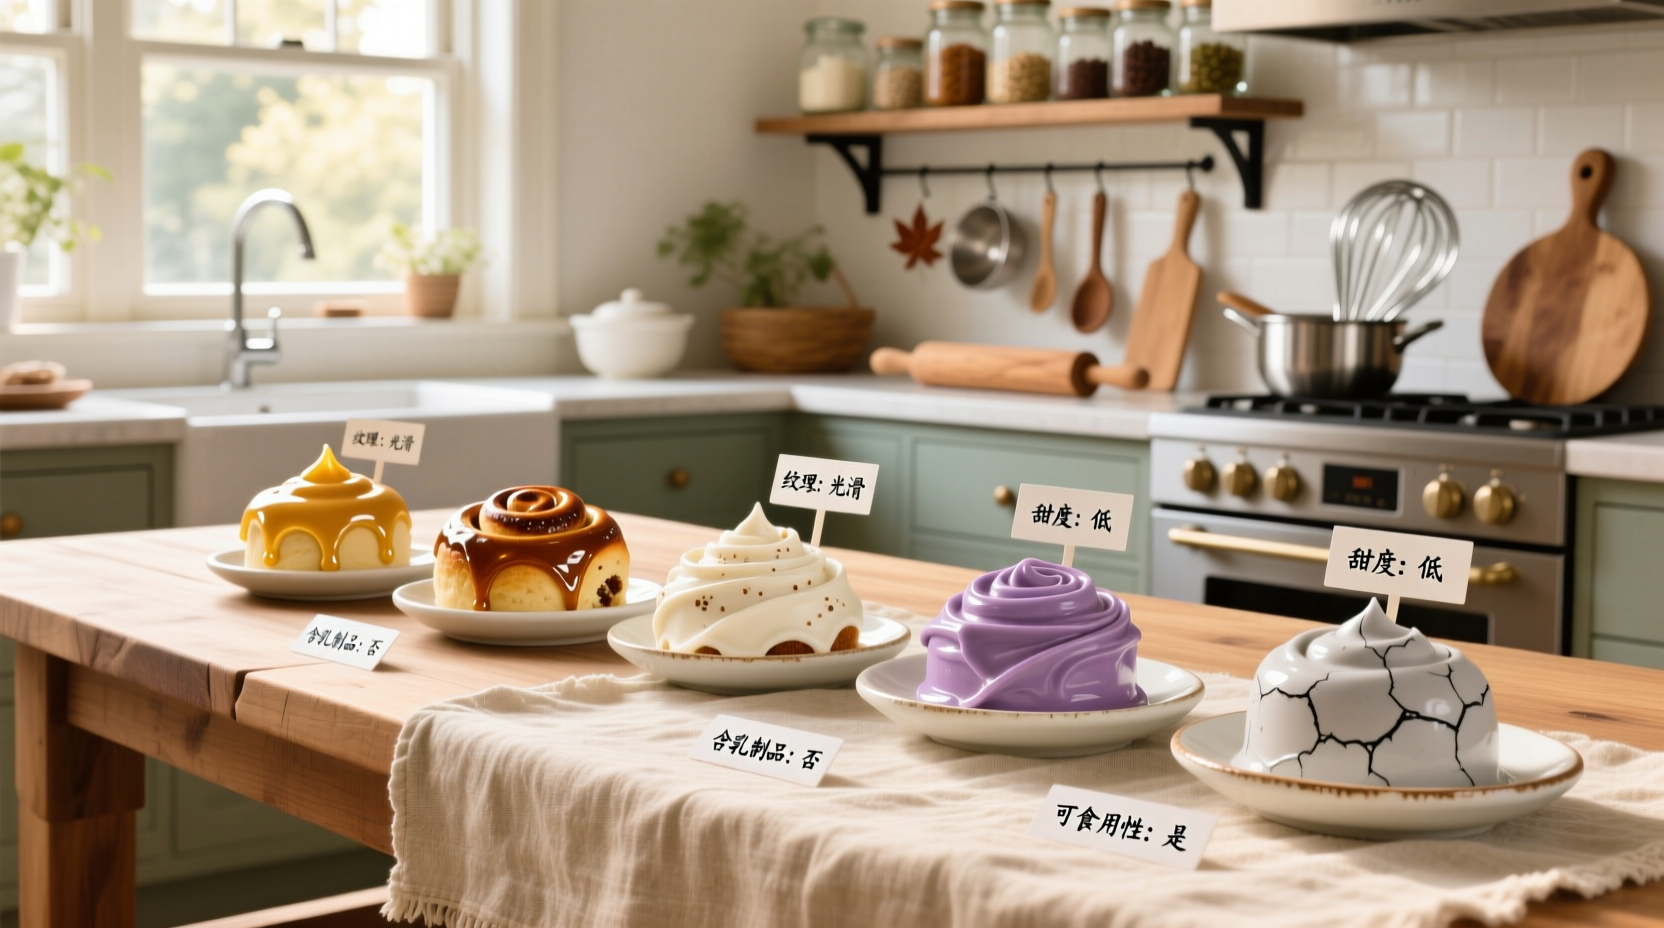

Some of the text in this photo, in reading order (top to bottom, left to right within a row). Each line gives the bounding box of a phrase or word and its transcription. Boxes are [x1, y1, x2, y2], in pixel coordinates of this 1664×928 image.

[1031, 503, 1112, 533] 甜度：低
[1347, 547, 1443, 583] 甜度：低
[1056, 803, 1187, 852] 可食用性：是
